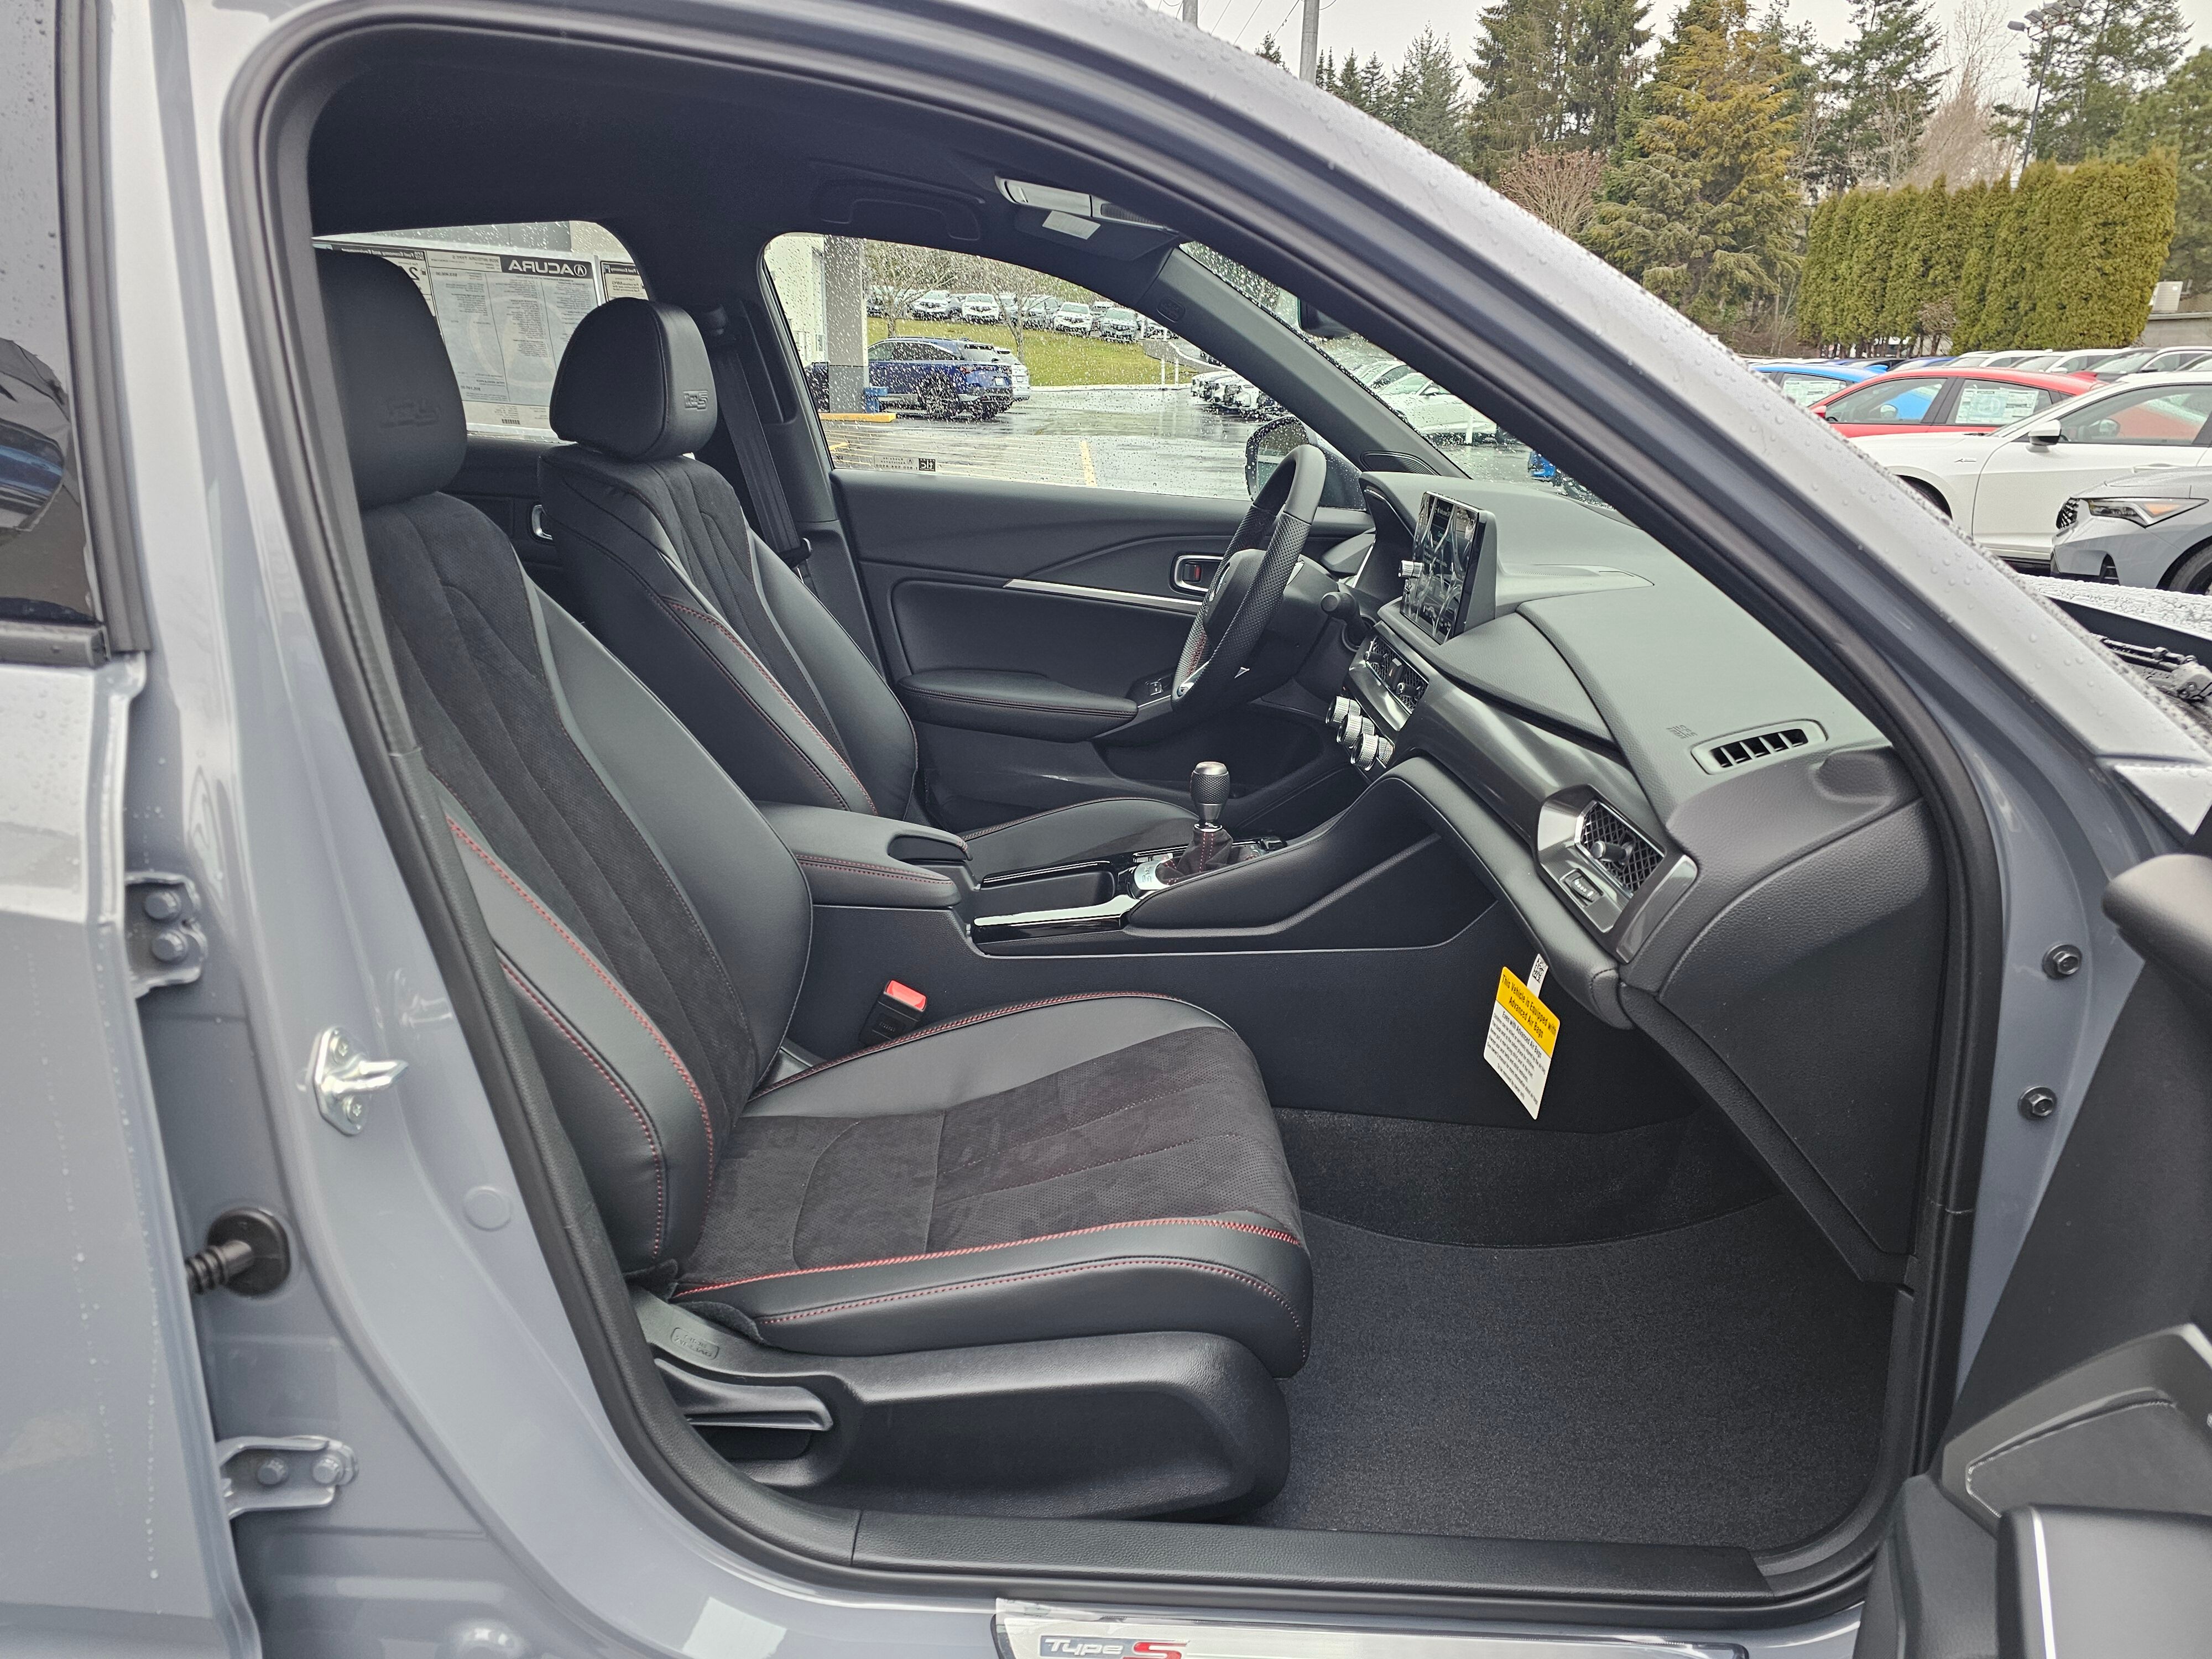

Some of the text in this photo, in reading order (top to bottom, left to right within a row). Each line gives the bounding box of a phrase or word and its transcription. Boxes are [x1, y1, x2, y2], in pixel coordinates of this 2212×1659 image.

[1502, 974, 1510, 989] This
[1511, 982, 1525, 1003] Vehicle
[1530, 1001, 1548, 1026] Equipped
[1548, 1022, 1556, 1036] with
[1509, 997, 1527, 1020] Advanced
[1533, 1021, 1543, 1039] Bags
[1516, 1025, 1530, 1045] Advanced
[1045, 1639, 1123, 1656] Type
